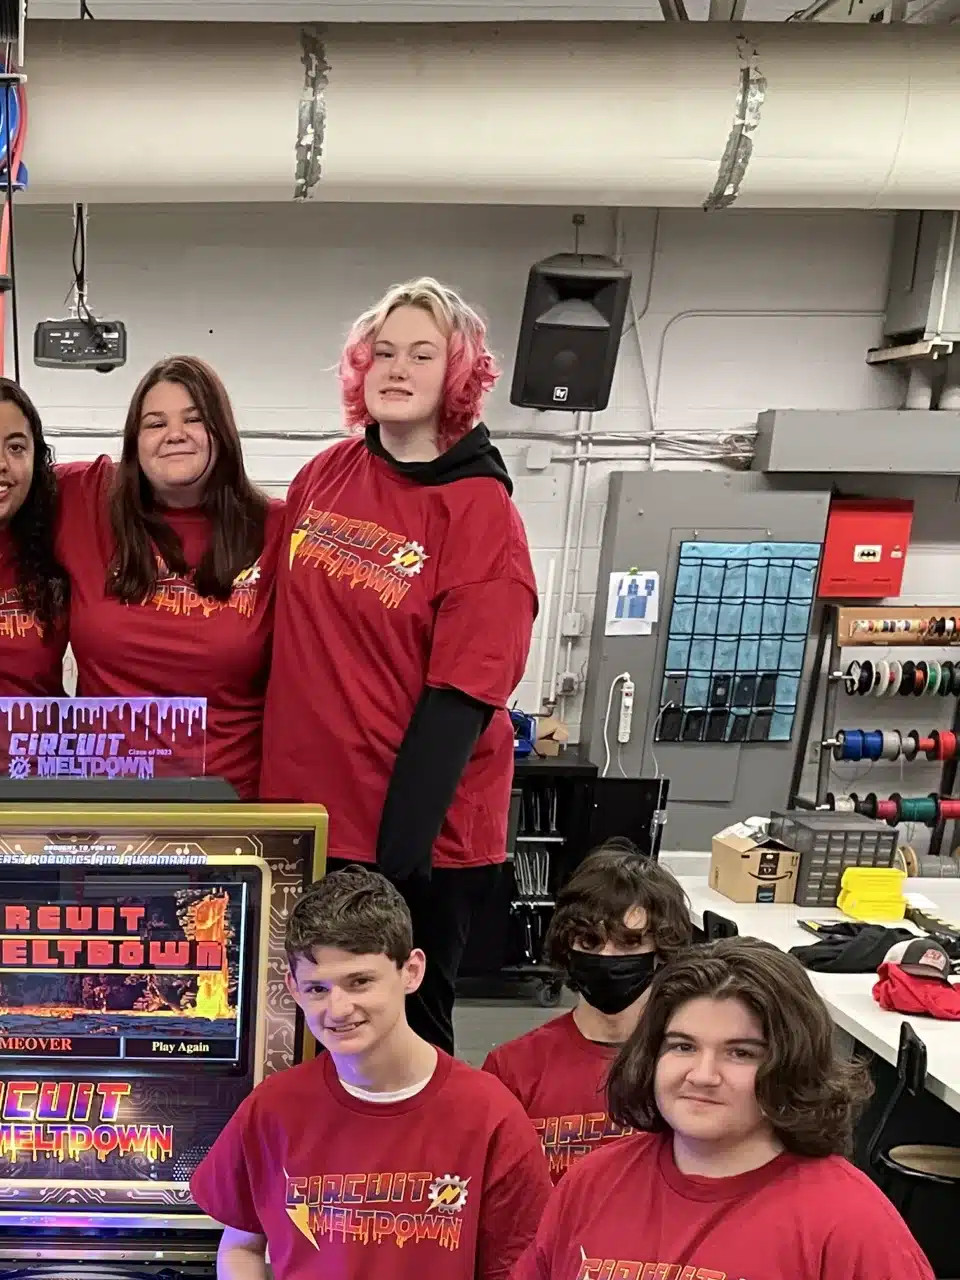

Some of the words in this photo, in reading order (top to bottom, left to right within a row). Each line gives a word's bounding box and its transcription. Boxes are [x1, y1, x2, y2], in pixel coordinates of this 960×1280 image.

[296, 509, 407, 557] CIRCUIT
[296, 532, 412, 609] MELTDOWN
[8, 733, 126, 756] CIRCUIT
[37, 756, 155, 779] MELTDOWN
[30, 854, 92, 866] ROBOTICS
[97, 855, 120, 866] AND
[124, 855, 208, 866] AUTOMATION
[151, 1040, 174, 1054] Play
[176, 1041, 210, 1055] Again
[286, 1171, 433, 1205] CIRCUIT
[307, 1205, 463, 1251] MELTDOWN
